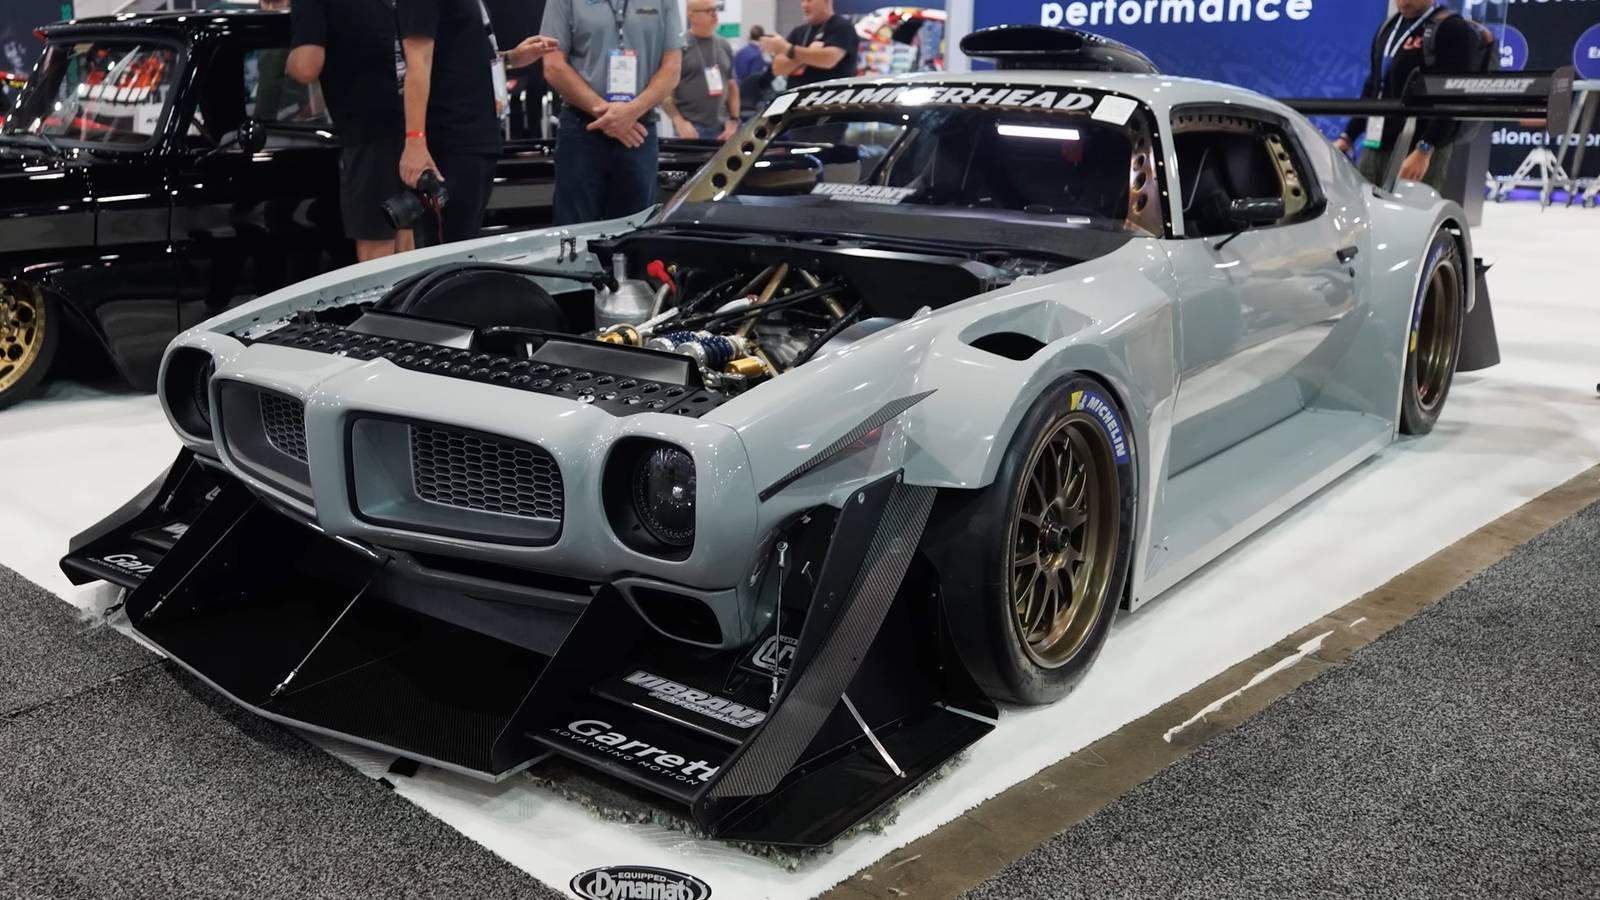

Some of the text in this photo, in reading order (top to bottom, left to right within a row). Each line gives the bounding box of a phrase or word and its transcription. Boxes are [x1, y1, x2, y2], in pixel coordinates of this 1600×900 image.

[1041, 0, 1313, 26] performance
[811, 182, 917, 201] VIBRANT
[1086, 396, 1126, 457] MICHELIN
[103, 553, 155, 574] Garr
[623, 670, 767, 726] VIBRANT
[550, 727, 699, 785] ADVANCING MOTION
[567, 719, 720, 782] Garrett
[594, 871, 688, 900] Dynamat
[618, 871, 667, 882] EQUIPPED
